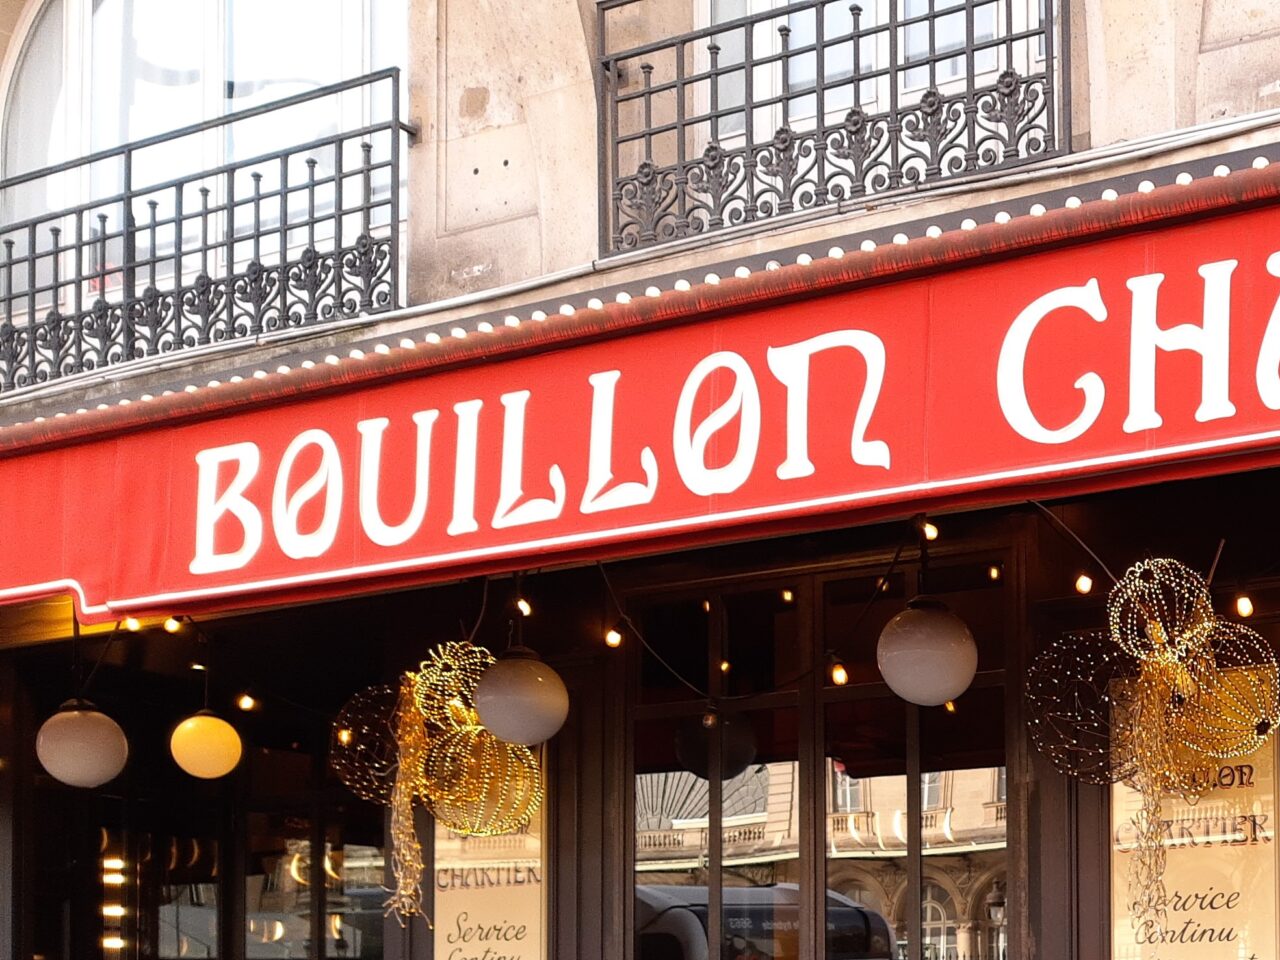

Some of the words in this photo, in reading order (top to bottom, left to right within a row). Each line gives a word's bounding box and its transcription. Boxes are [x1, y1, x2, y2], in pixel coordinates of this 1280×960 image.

[189, 329, 891, 575] BOUILLON
[1115, 813, 1272, 853] CARTIER
[447, 911, 527, 944] Service
[1135, 918, 1238, 944] Continu
